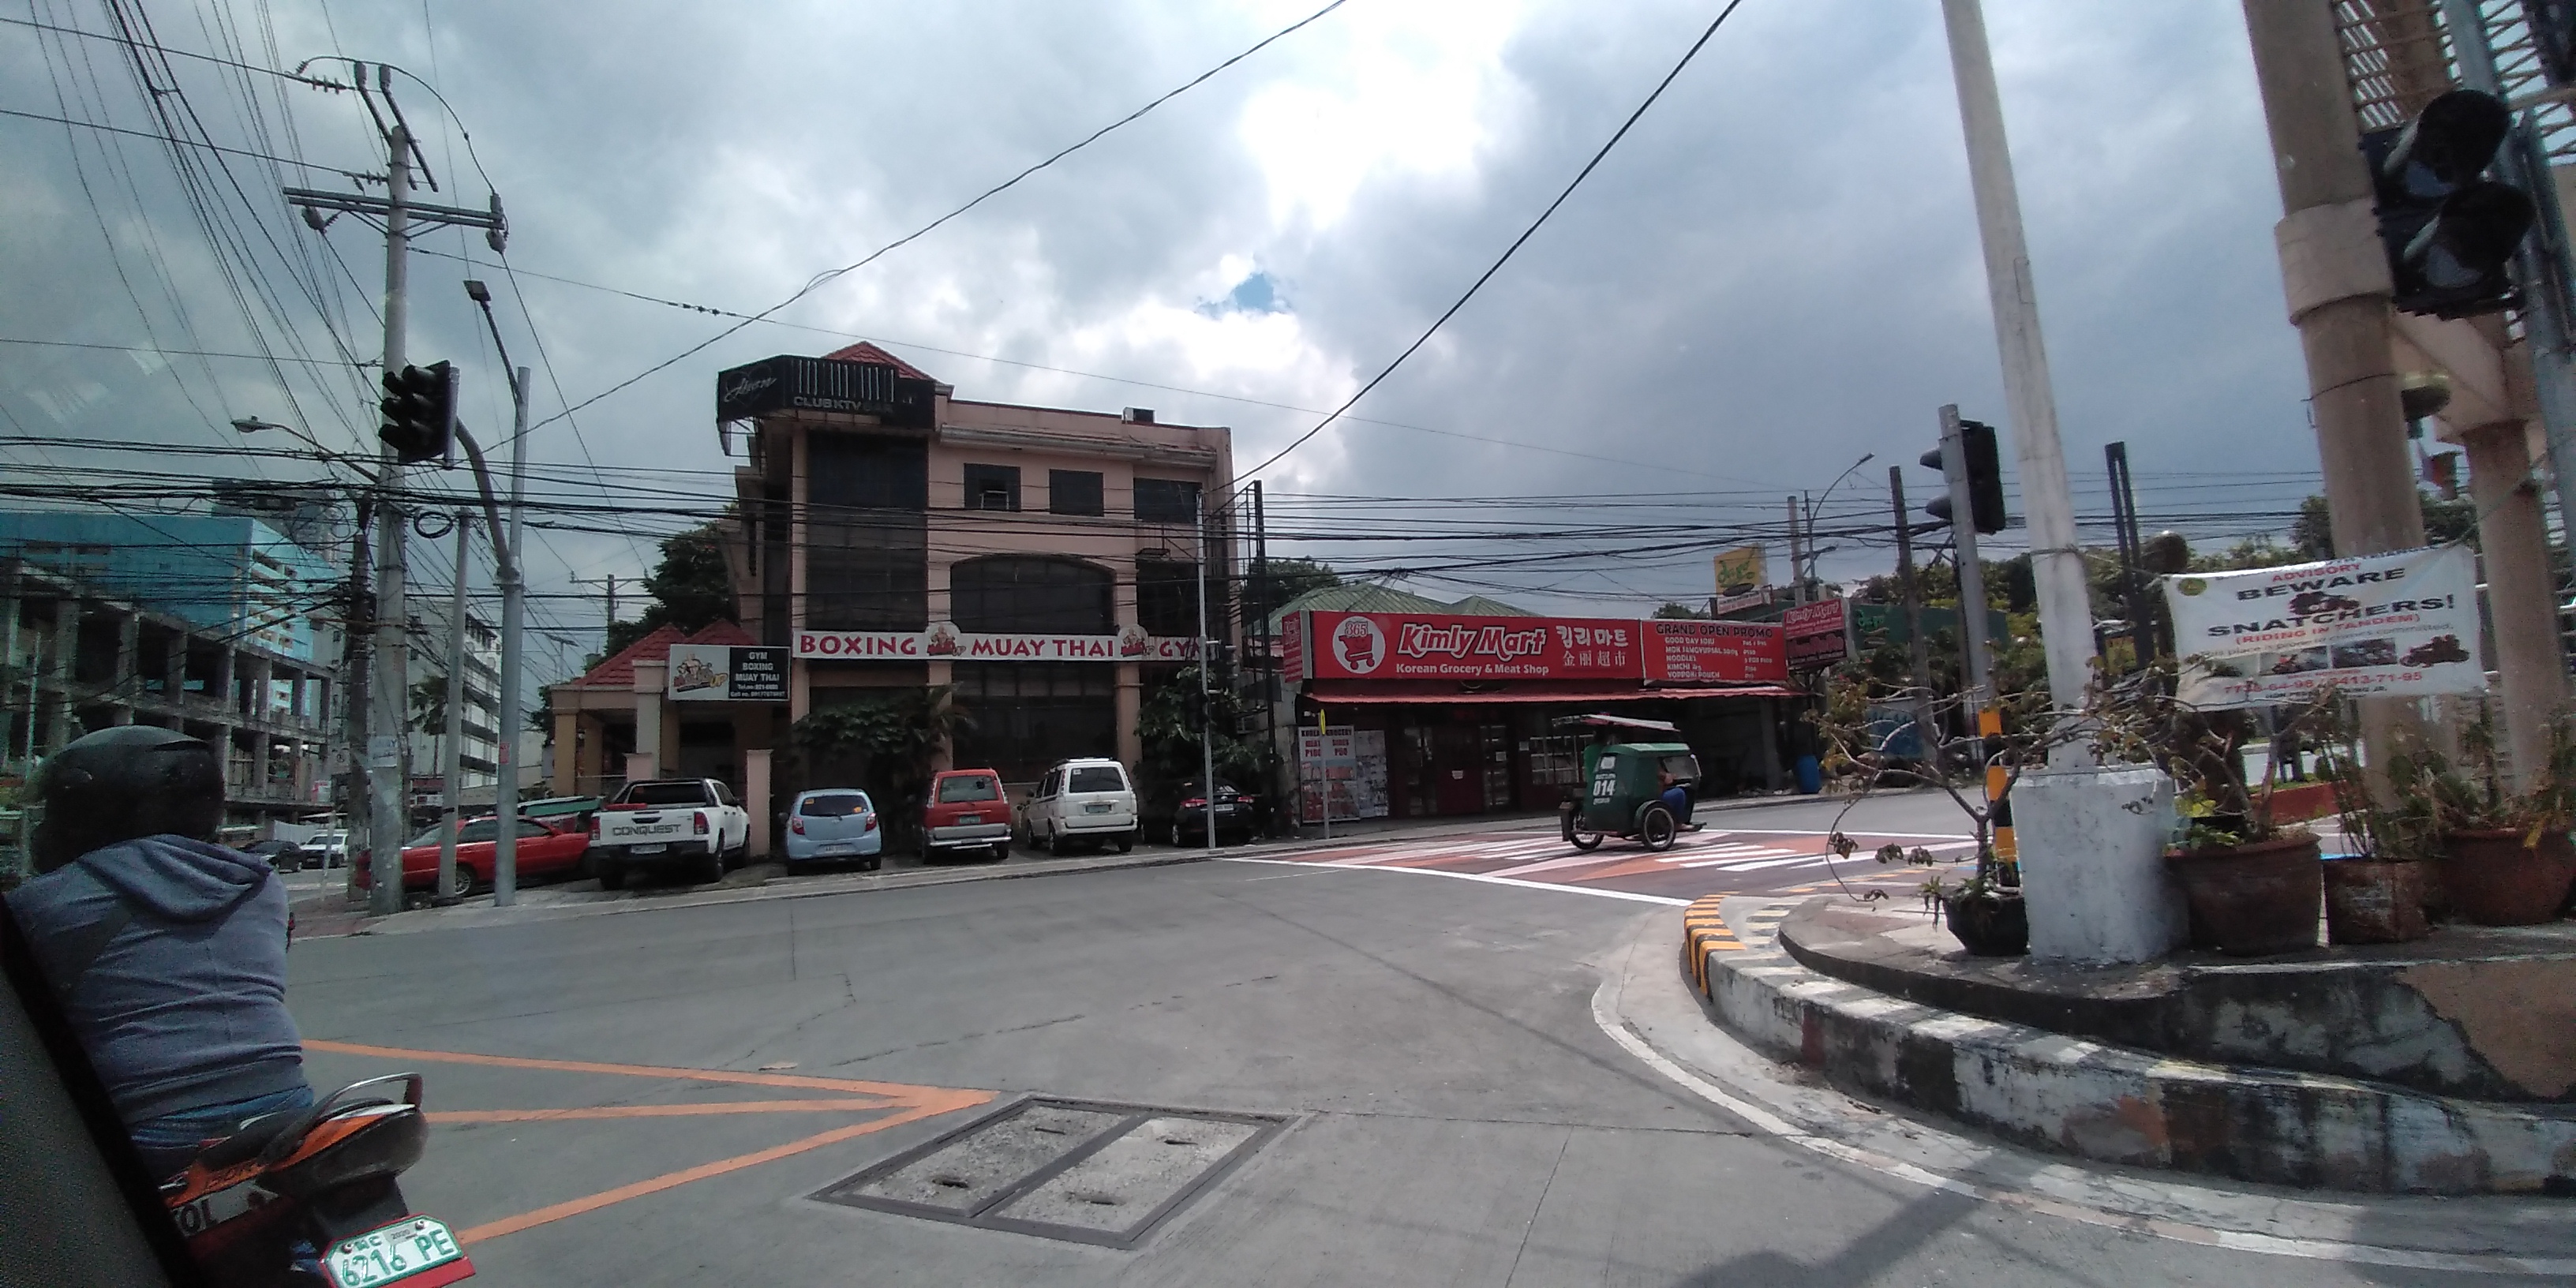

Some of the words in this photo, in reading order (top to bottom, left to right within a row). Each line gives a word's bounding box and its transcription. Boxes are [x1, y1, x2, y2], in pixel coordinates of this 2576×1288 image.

[793, 396, 832, 408] CLUB
[833, 399, 862, 410] KTV
[2272, 563, 2362, 582] ADVISORY
[2237, 567, 2407, 601] BEWARE
[2207, 594, 2455, 637] SNATCHERS!
[1345, 620, 1368, 638] 365
[1657, 623, 1696, 635] GRAND
[1699, 625, 1730, 637] OPEN
[1733, 627, 1773, 638] PROMO
[2236, 628, 2306, 645] (RIDING
[2335, 613, 2421, 631] TANDEM)
[800, 635, 917, 656] BOXING
[971, 638, 1046, 657] MUAY
[1052, 638, 1114, 657] THAI
[1398, 623, 1477, 659] Kimly
[1474, 626, 1546, 661] Mart
[749, 651, 768, 660] GYM
[742, 662, 773, 671] BOXING
[1396, 664, 1437, 674] Korean
[1440, 664, 1484, 676] Grocery
[1485, 665, 1492, 673] &
[1495, 665, 1520, 673] Meat
[1523, 665, 1549, 676] Shop
[735, 673, 758, 682] MUAY
[760, 673, 780, 682] THAI
[1593, 780, 1616, 796] 014
[612, 824, 682, 837] CONQUEST
[342, 1244, 407, 1286] 6216
[414, 1228, 455, 1262] PE
